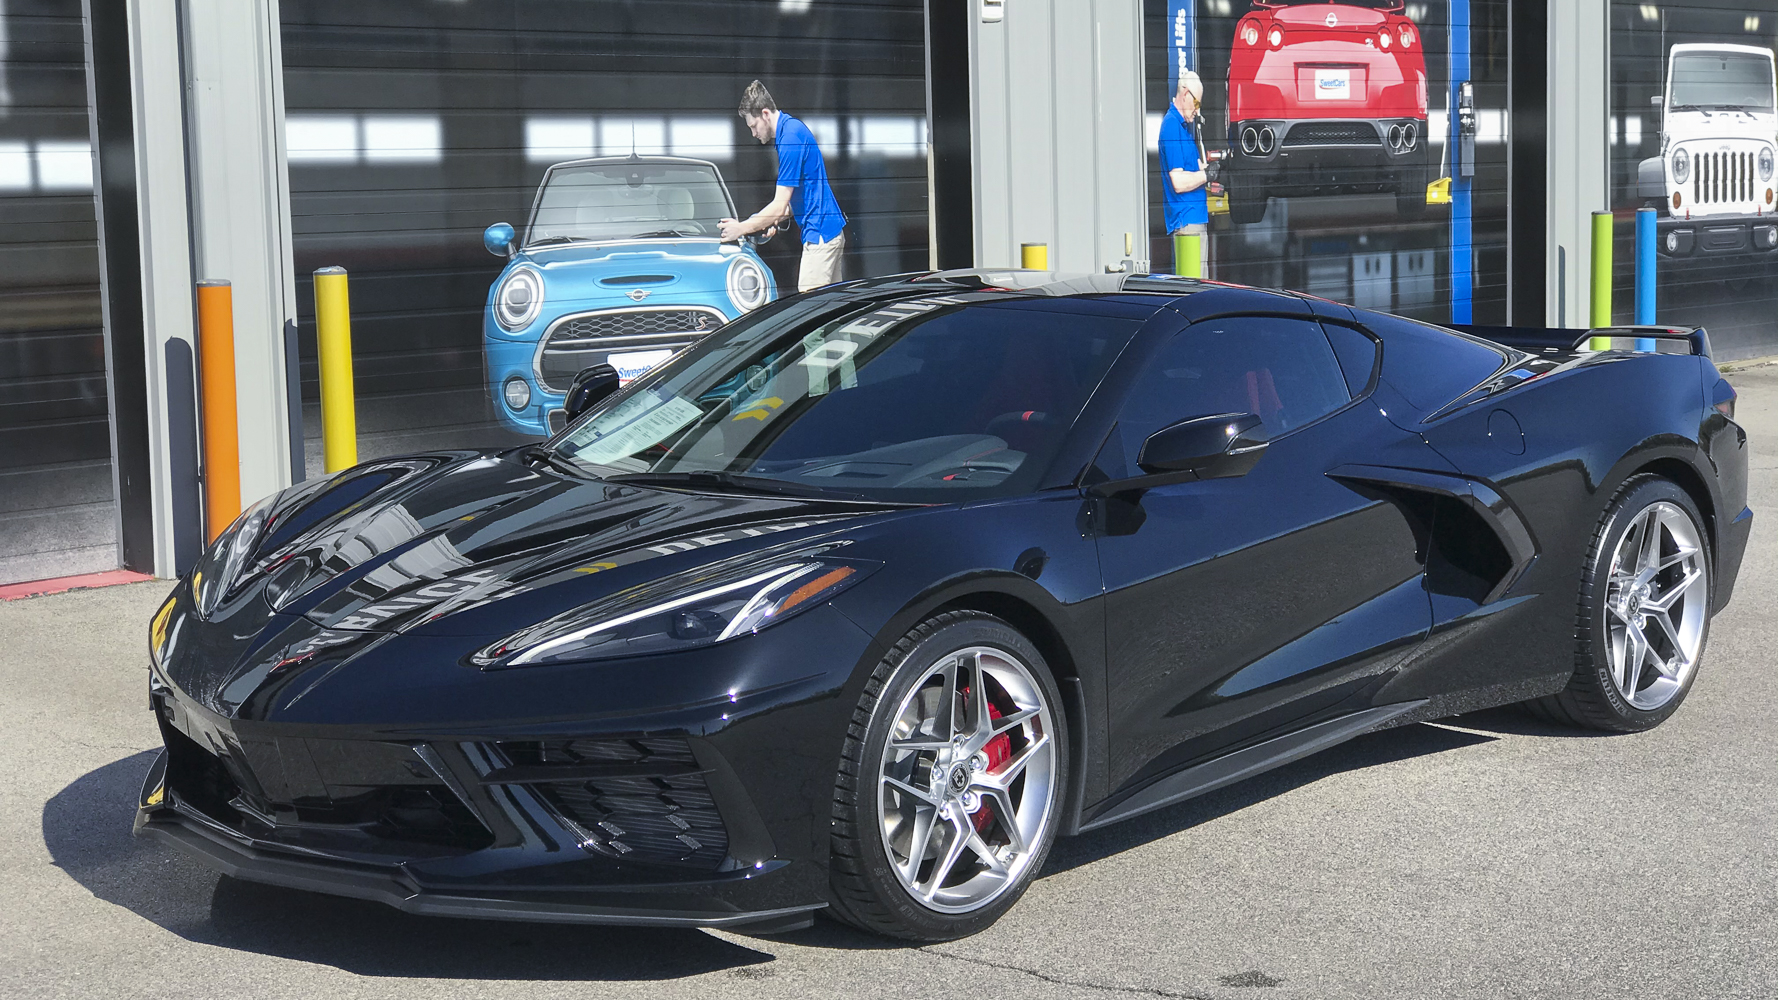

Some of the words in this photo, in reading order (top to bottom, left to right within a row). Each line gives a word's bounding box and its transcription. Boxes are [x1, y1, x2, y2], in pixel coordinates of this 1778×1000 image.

[1174, 8, 1186, 47] Lifts
[1178, 48, 1188, 79] ger
[1320, 79, 1346, 87] SweetCars
[1598, 668, 1627, 717] MICHELIN
